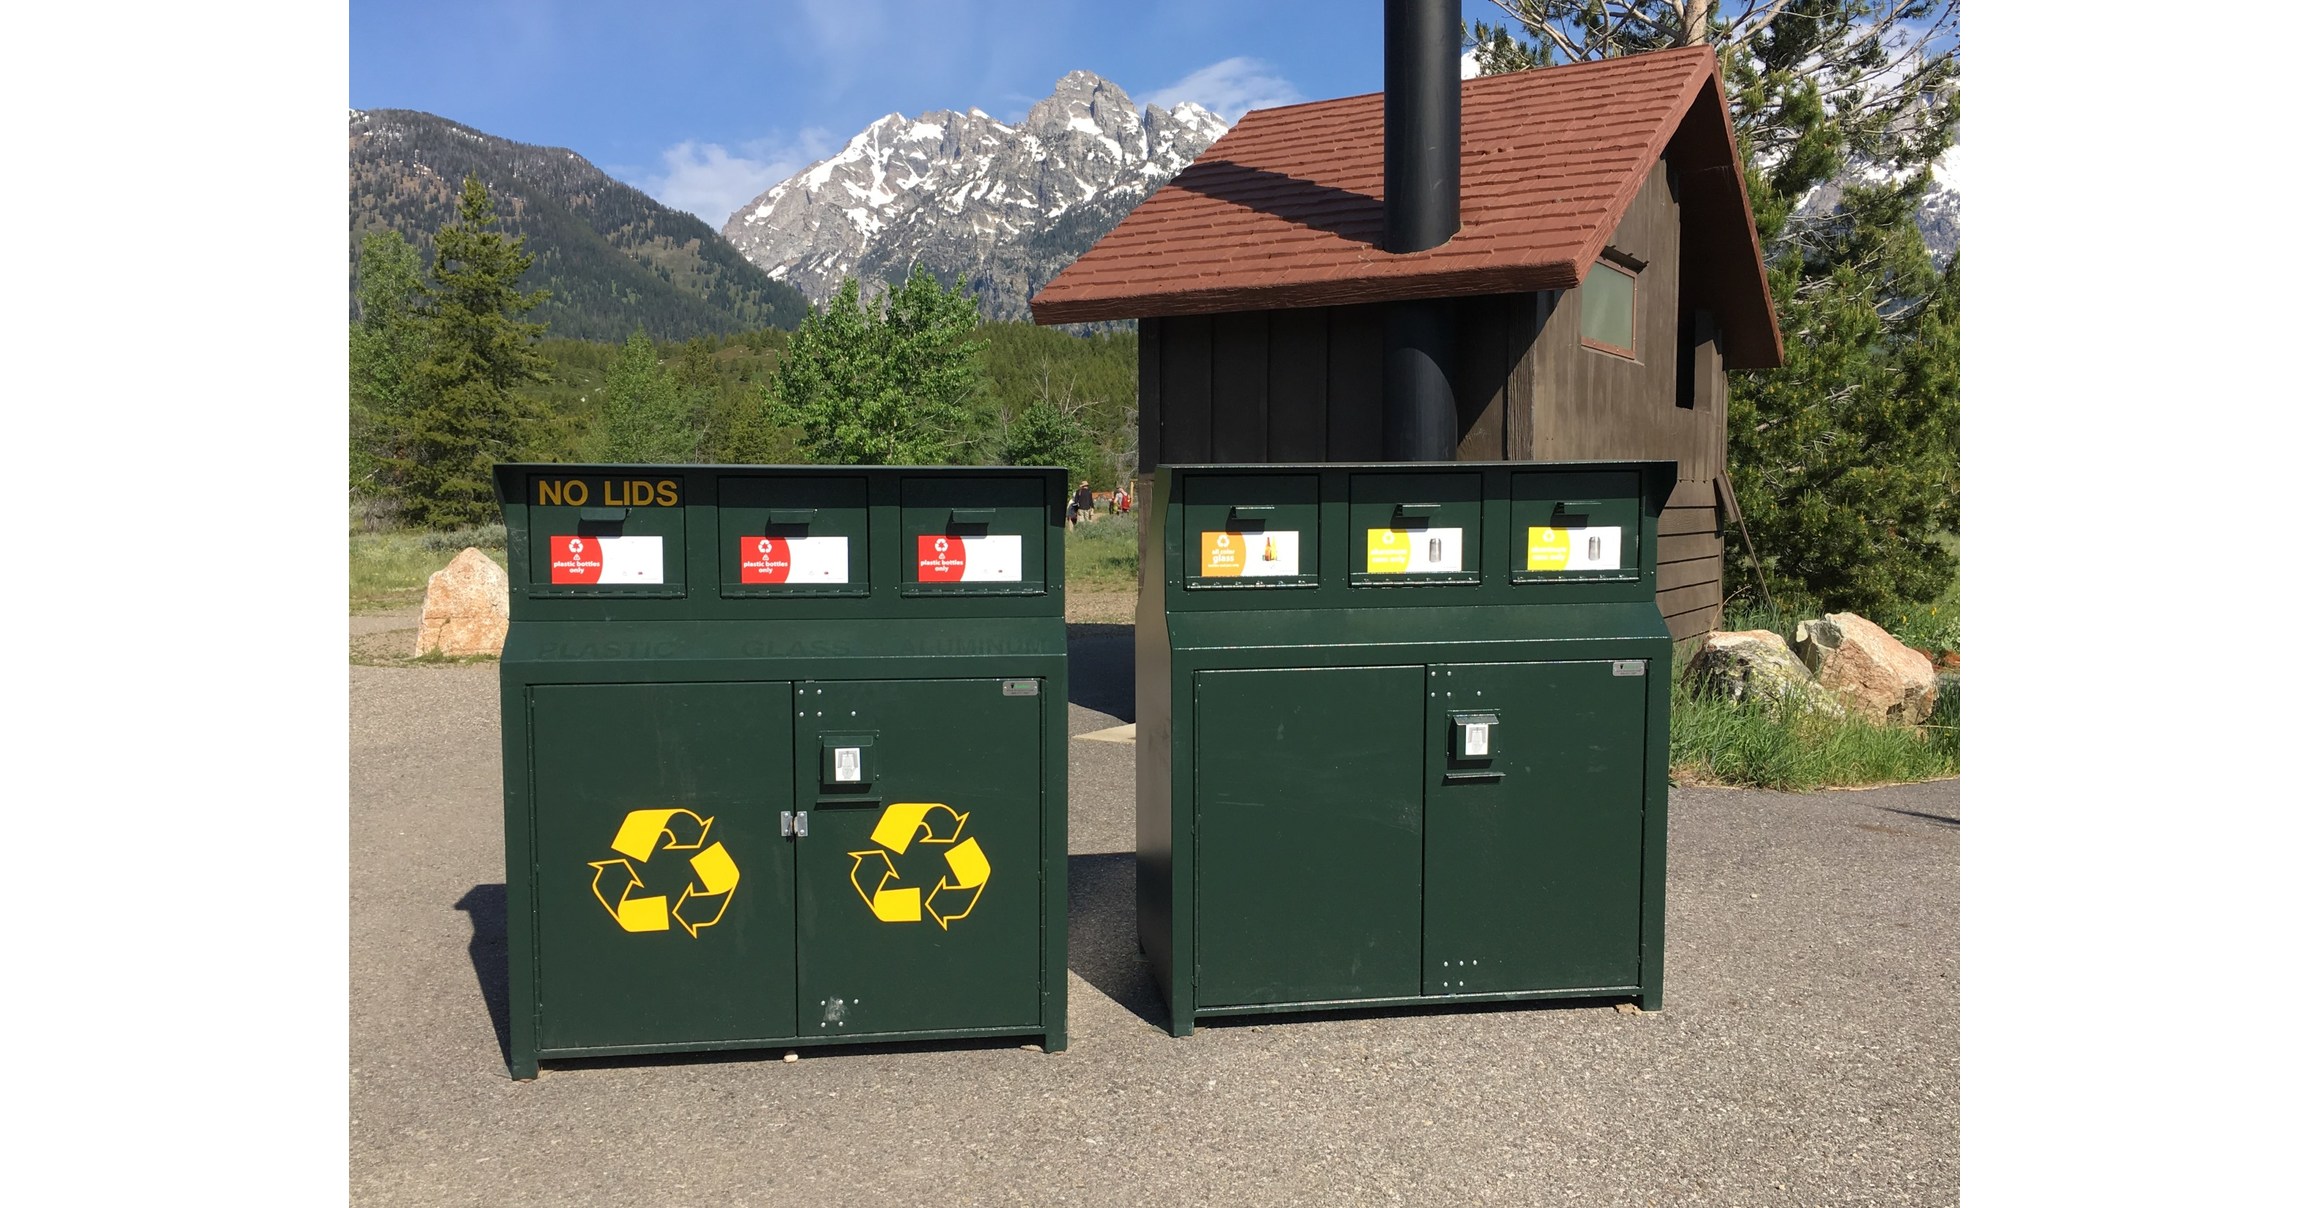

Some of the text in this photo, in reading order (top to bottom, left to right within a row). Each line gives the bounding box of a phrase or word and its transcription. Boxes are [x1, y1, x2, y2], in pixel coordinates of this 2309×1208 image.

[538, 480, 678, 507] NO LIDS
[1212, 554, 1235, 564] glass
[537, 640, 677, 659] PLASTIC
[741, 639, 851, 658] GLASS
[900, 636, 1049, 655] ALUMINUM
